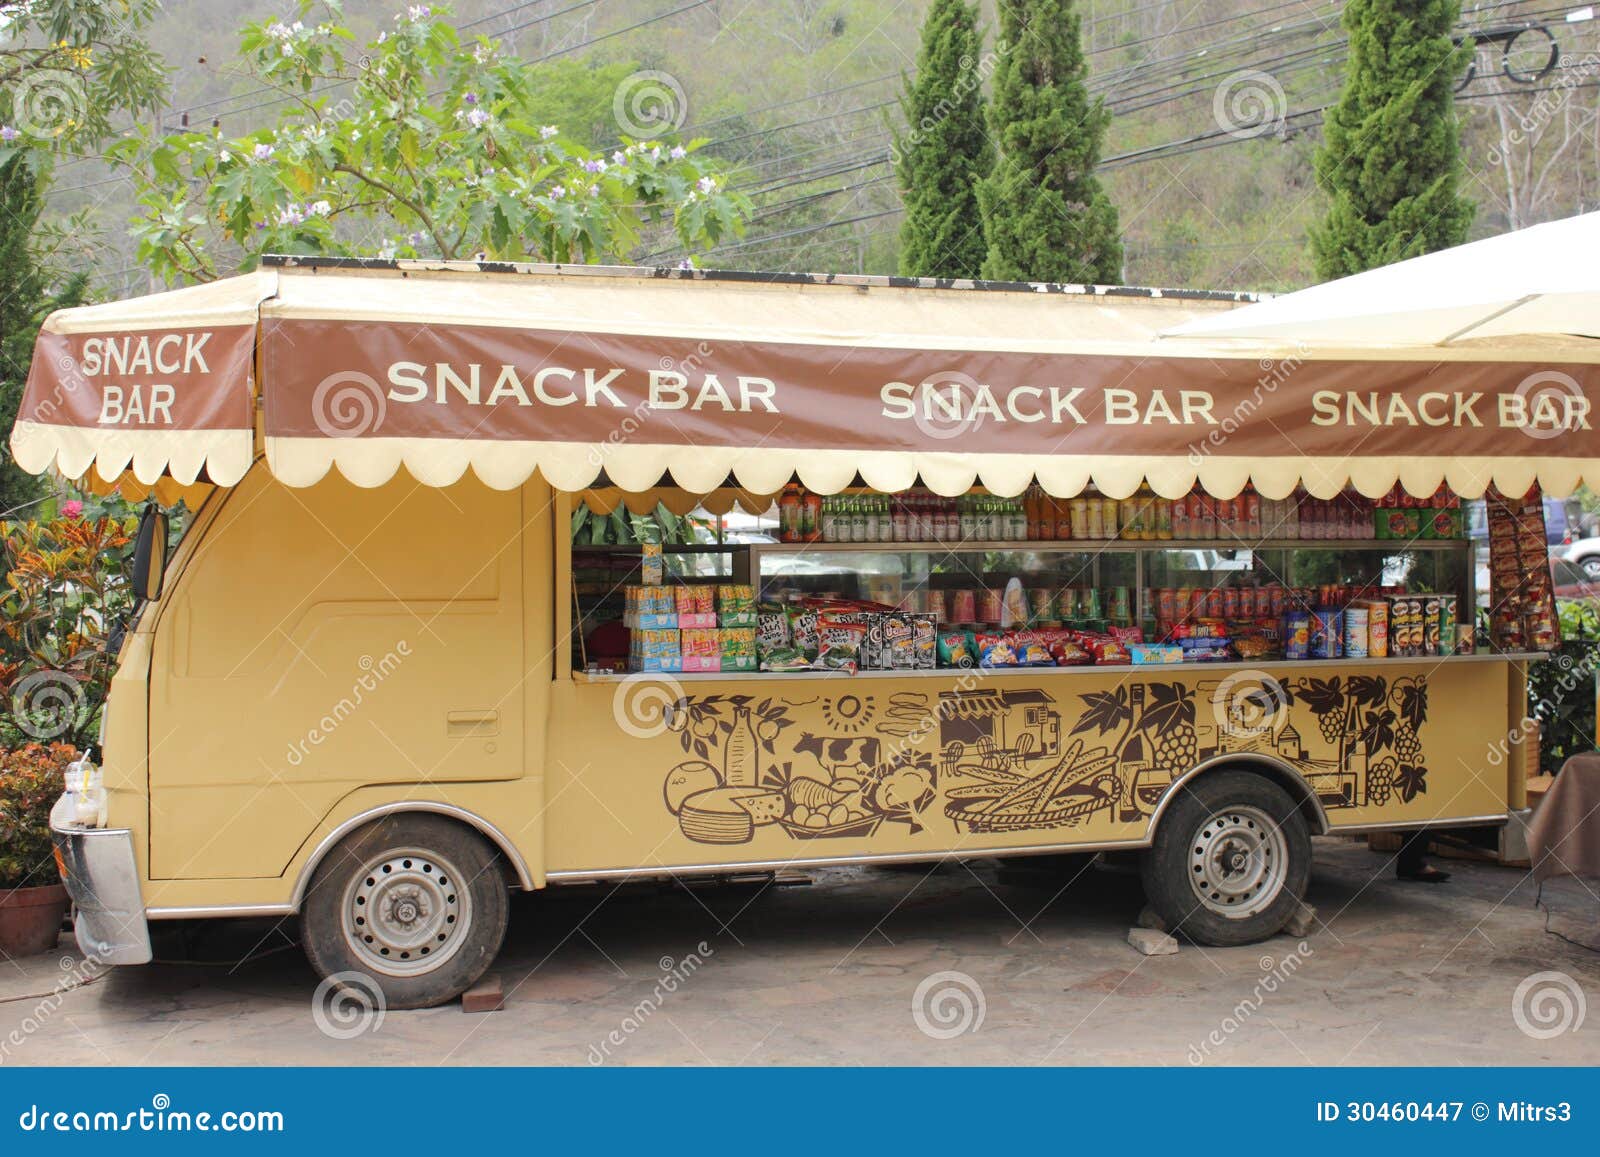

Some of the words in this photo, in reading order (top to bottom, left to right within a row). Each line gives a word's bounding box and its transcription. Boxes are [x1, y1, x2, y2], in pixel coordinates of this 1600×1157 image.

[82, 332, 213, 376] SNACK
[97, 384, 176, 424] BAR
[387, 361, 627, 408] SNACK
[647, 369, 780, 414] BAR
[880, 381, 1087, 425] SNACK
[1103, 387, 1219, 425] BAR
[1311, 389, 1484, 427] SNACK
[1497, 392, 1593, 430] BAR
